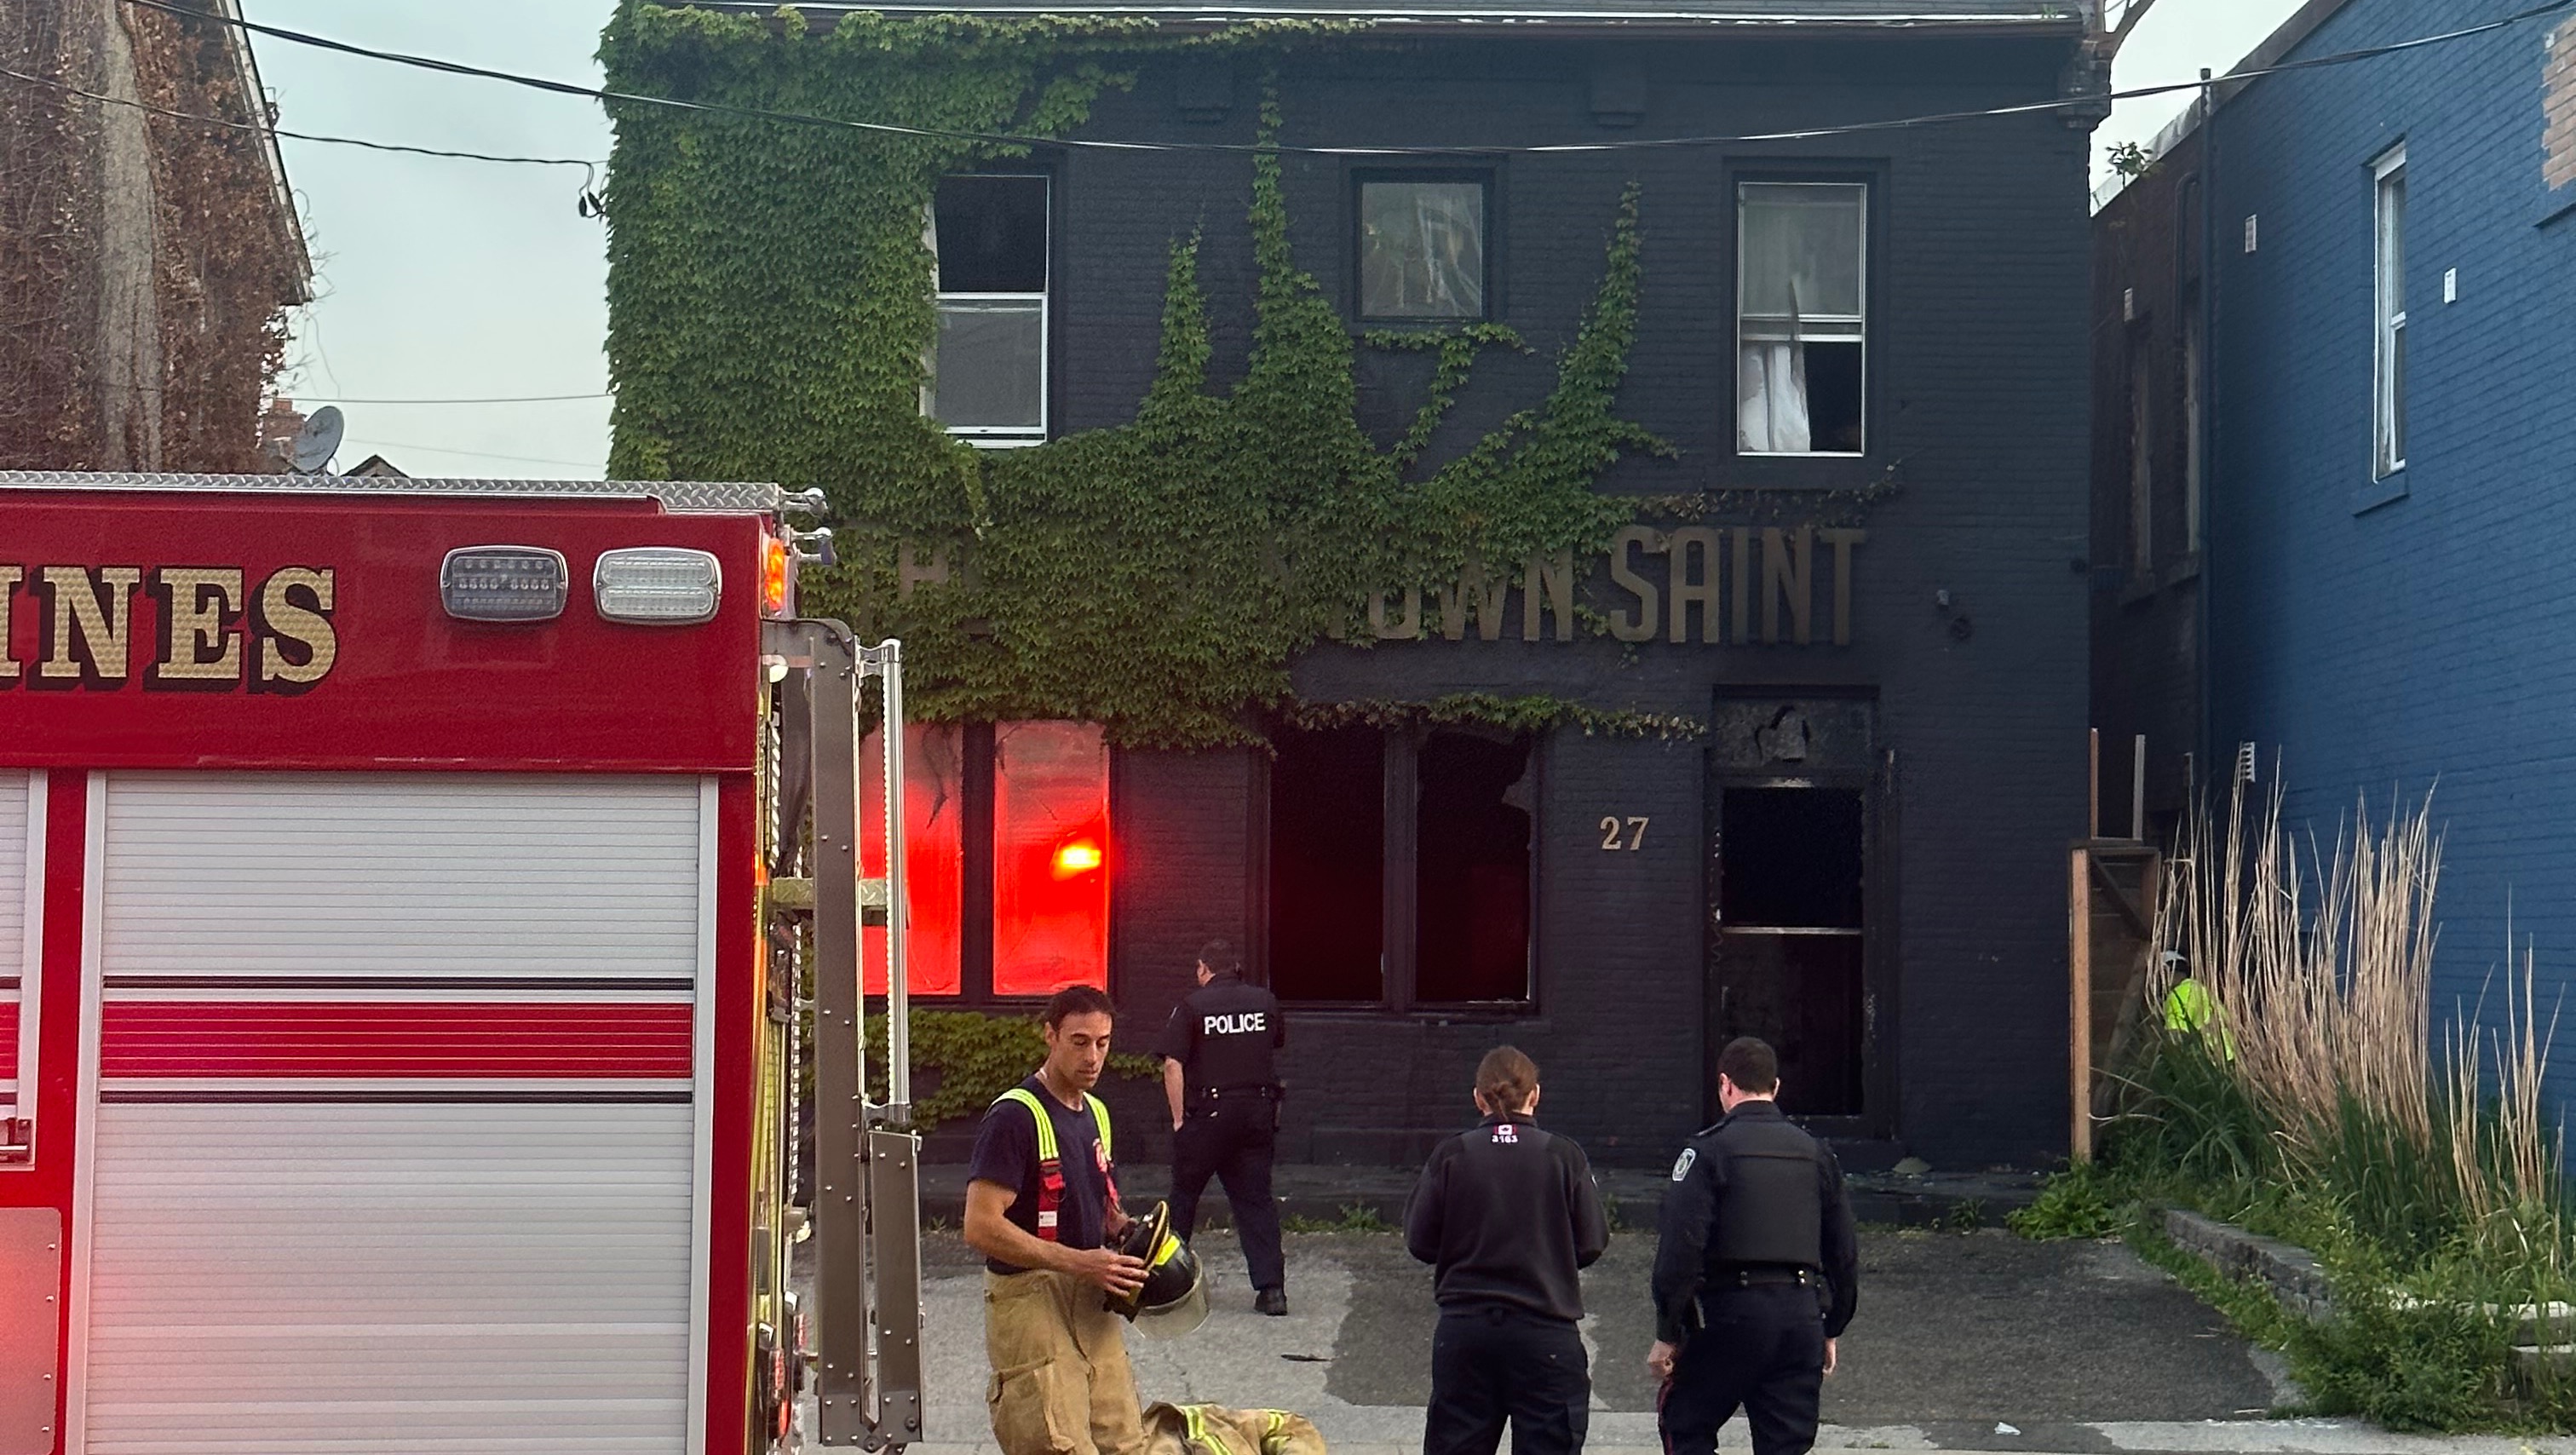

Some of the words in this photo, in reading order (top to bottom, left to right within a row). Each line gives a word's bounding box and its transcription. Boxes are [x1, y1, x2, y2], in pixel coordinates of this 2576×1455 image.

[1327, 537, 1573, 641] OWN
[1609, 524, 1867, 646] SAINT
[1600, 815, 1650, 851] 27
[1204, 1011, 1267, 1035] POLICE
